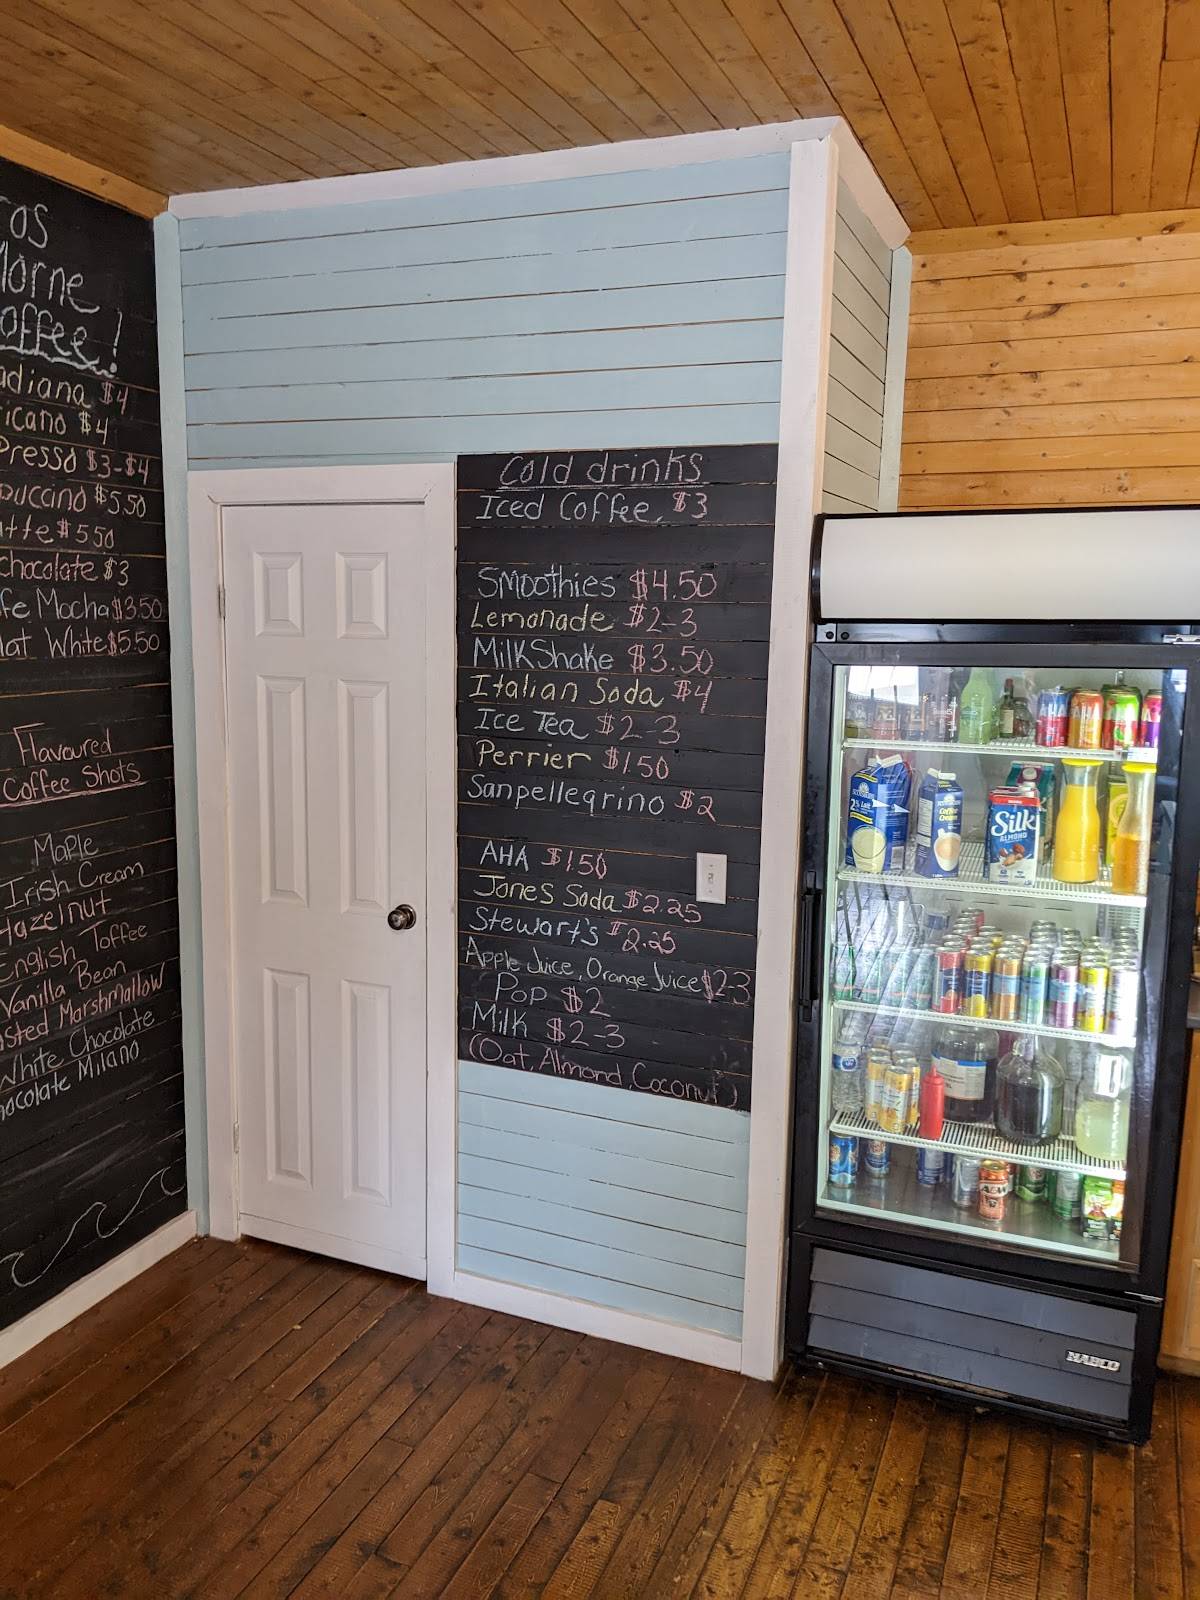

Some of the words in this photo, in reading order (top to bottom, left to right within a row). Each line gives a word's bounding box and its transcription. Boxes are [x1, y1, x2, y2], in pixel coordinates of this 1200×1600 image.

[101, 381, 129, 415] $4
[0, 401, 66, 435] icano
[78, 410, 109, 445] $4
[86, 449, 150, 485] $3-$4
[500, 455, 574, 485] Cold
[587, 449, 703, 483] drinks
[95, 482, 147, 518] $5.50
[476, 493, 545, 520] Iced
[560, 492, 663, 523] Coffee
[672, 491, 708, 519] $3
[103, 556, 130, 586] $3
[476, 564, 616, 599] Smoothies
[629, 568, 717, 602] $4.50
[36, 587, 109, 620] Mocha
[111, 595, 162, 622] $3.50
[471, 602, 615, 632] Lemonade
[624, 603, 698, 637] $2-3
[45, 624, 107, 659] White
[107, 629, 160, 656] $5.50
[627, 643, 714, 675] $3.50
[468, 674, 578, 702] Italian
[589, 677, 664, 708] Soda
[672, 679, 713, 714] $4
[474, 708, 525, 732] Ice
[533, 710, 590, 740] Tea
[13, 722, 113, 766] Flavoured
[476, 739, 592, 770] Perrier
[3, 768, 71, 801] Coffee
[82, 759, 141, 788] Shots
[674, 788, 717, 823] $2
[990, 809, 1037, 837] Silk
[1000, 831, 1028, 842] ALMOND
[480, 840, 529, 872] AHA
[0, 870, 70, 909] Irish
[78, 861, 144, 888] Cream
[473, 874, 554, 905] Jones
[563, 884, 623, 913] Soda
[625, 889, 701, 923] $2.25
[78, 919, 147, 951] Toffee
[469, 906, 599, 946] Stewart's
[465, 936, 520, 972] Apple
[587, 957, 649, 987] Orange
[652, 961, 702, 993] Juice
[0, 979, 66, 1019] Vanilla
[69, 958, 126, 990] Bean
[495, 972, 548, 1005] Pop
[560, 985, 611, 1018] $2
[69, 1008, 155, 1058] Chocolate
[472, 1001, 528, 1038] Milk
[547, 1017, 625, 1048] $2-3
[78, 1039, 139, 1083] Milano
